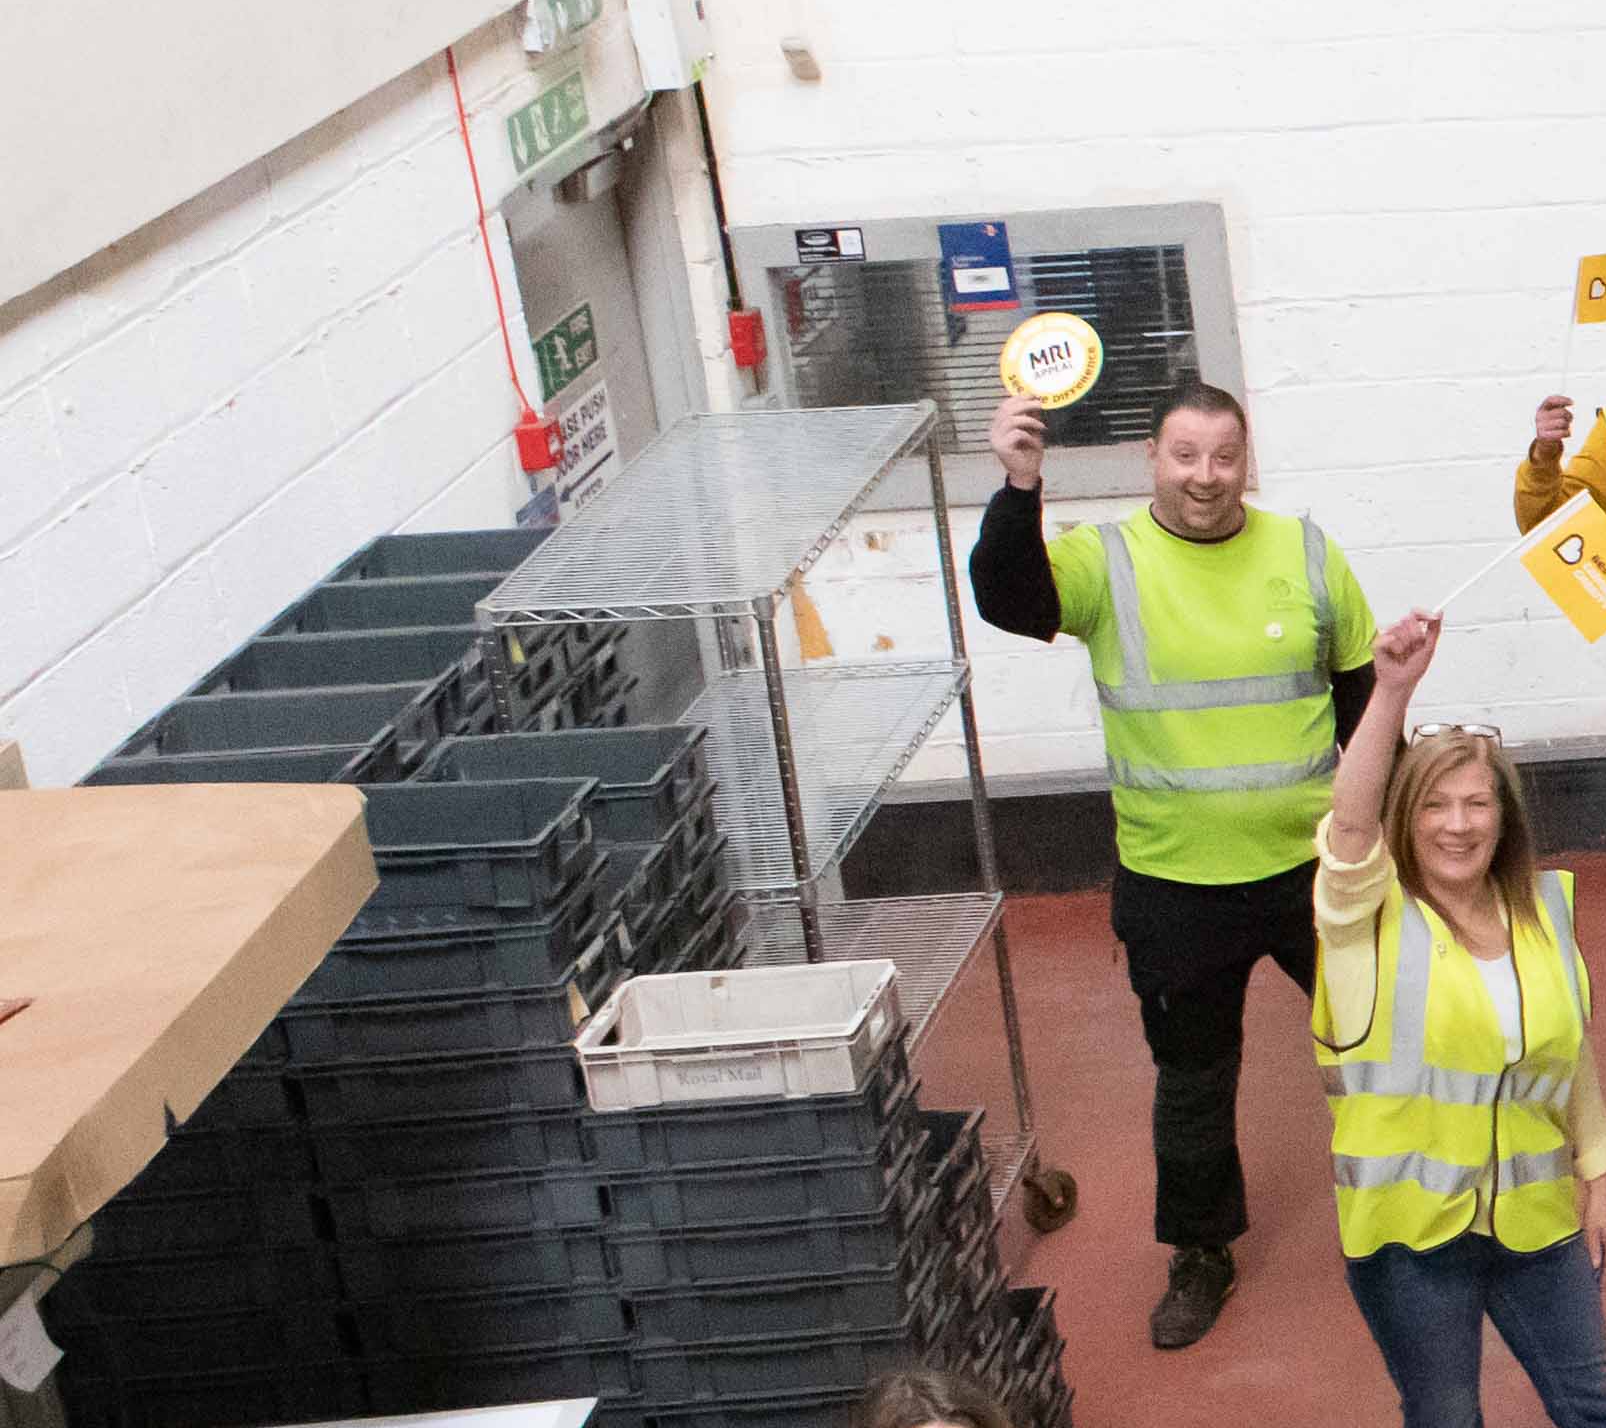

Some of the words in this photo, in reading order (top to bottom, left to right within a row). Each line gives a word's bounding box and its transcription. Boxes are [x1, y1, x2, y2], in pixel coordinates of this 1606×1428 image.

[1029, 341, 1071, 370] MRI
[677, 1065, 716, 1088] Royal
[721, 1062, 764, 1083] Mail
